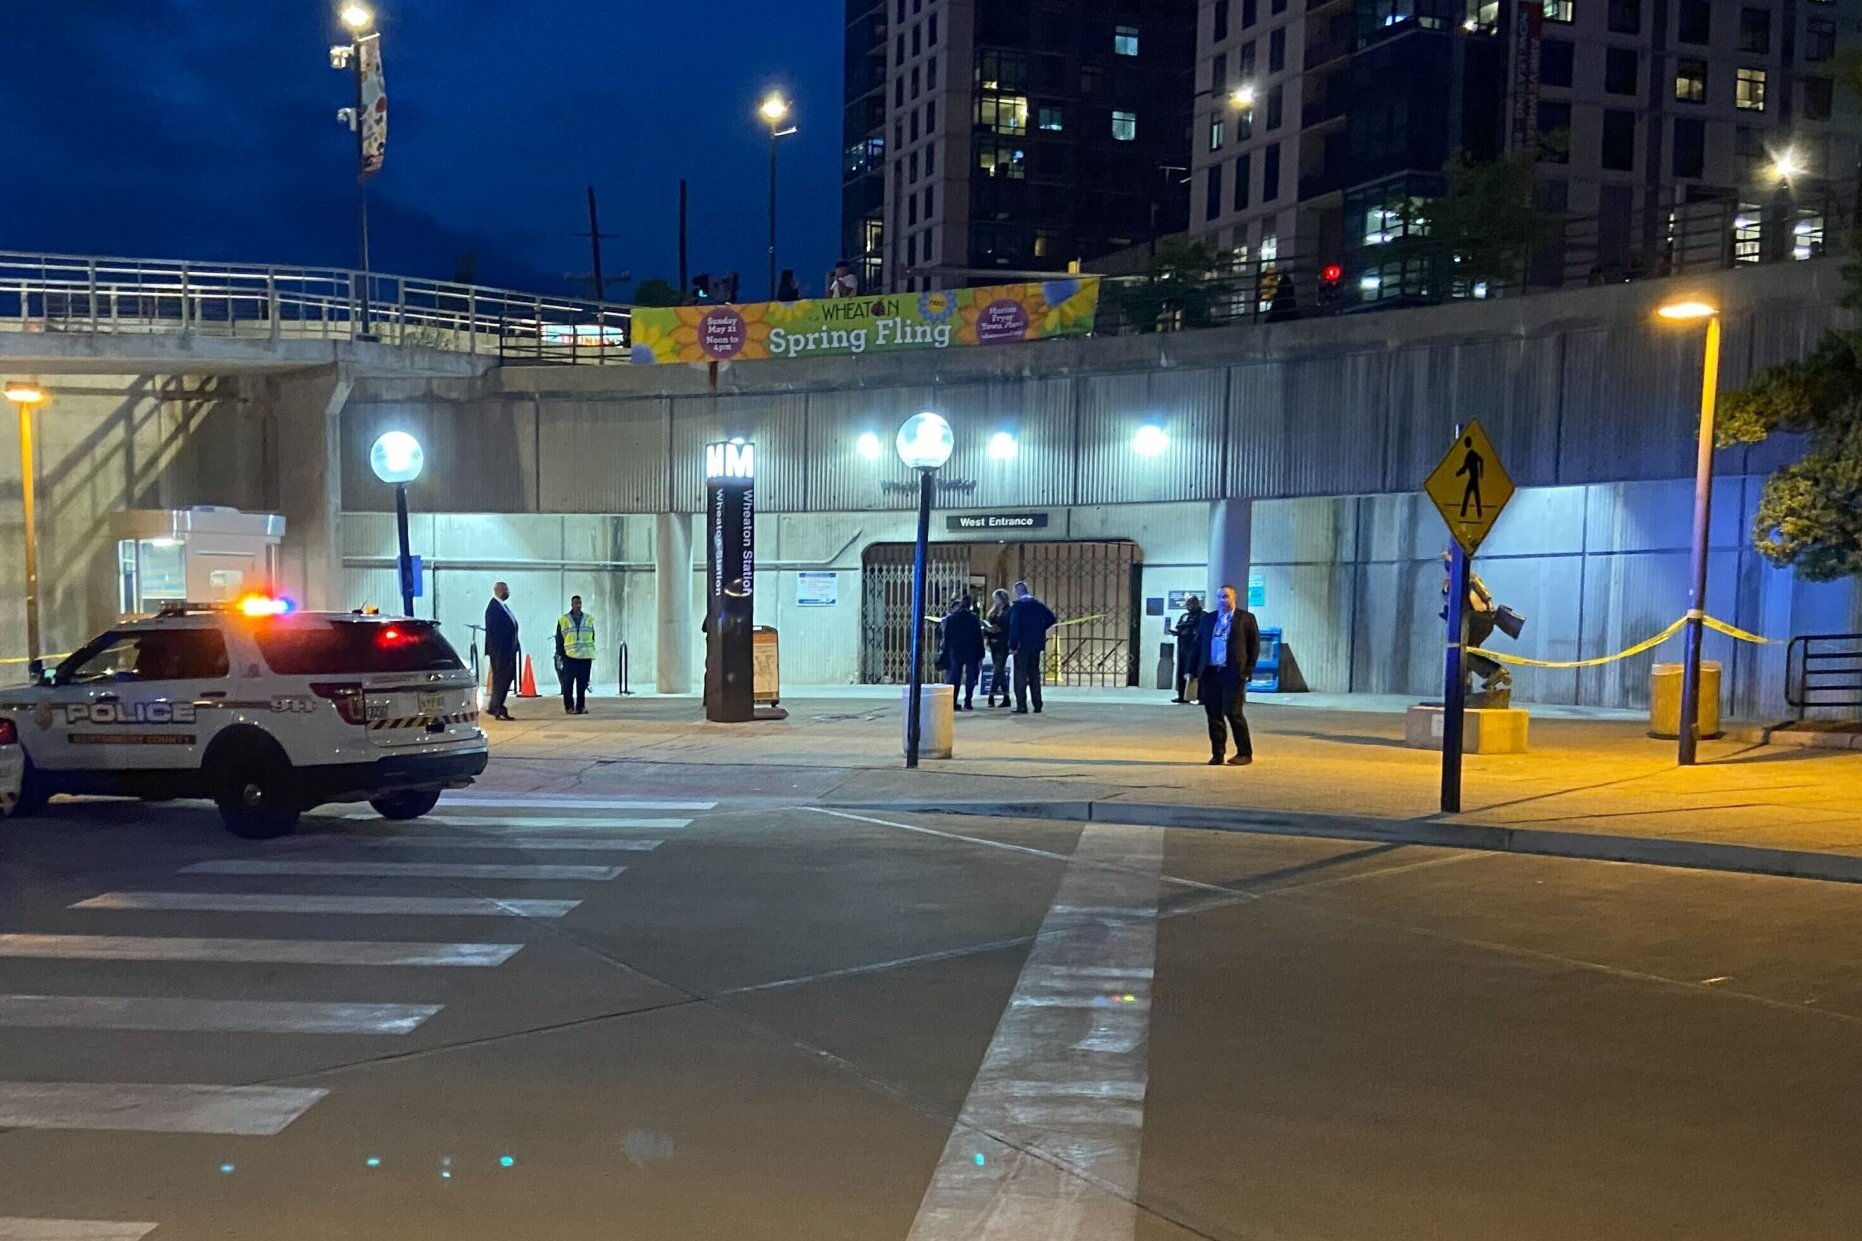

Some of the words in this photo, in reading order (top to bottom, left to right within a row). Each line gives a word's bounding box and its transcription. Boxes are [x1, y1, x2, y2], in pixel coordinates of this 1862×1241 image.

[822, 298, 900, 321] WHEATON
[707, 316, 738, 326] Sunday
[708, 326, 726, 334] May
[706, 336, 729, 344] Noon
[713, 344, 732, 352] 4pm
[769, 325, 867, 358] Spring
[875, 317, 952, 348] Fling
[725, 444, 754, 478] M
[715, 488, 724, 548] Wheaton
[742, 489, 754, 547] Wheaton
[960, 517, 986, 528] West
[989, 516, 1034, 527] Entrance
[742, 550, 754, 596] Station
[66, 702, 196, 724] POLICE
